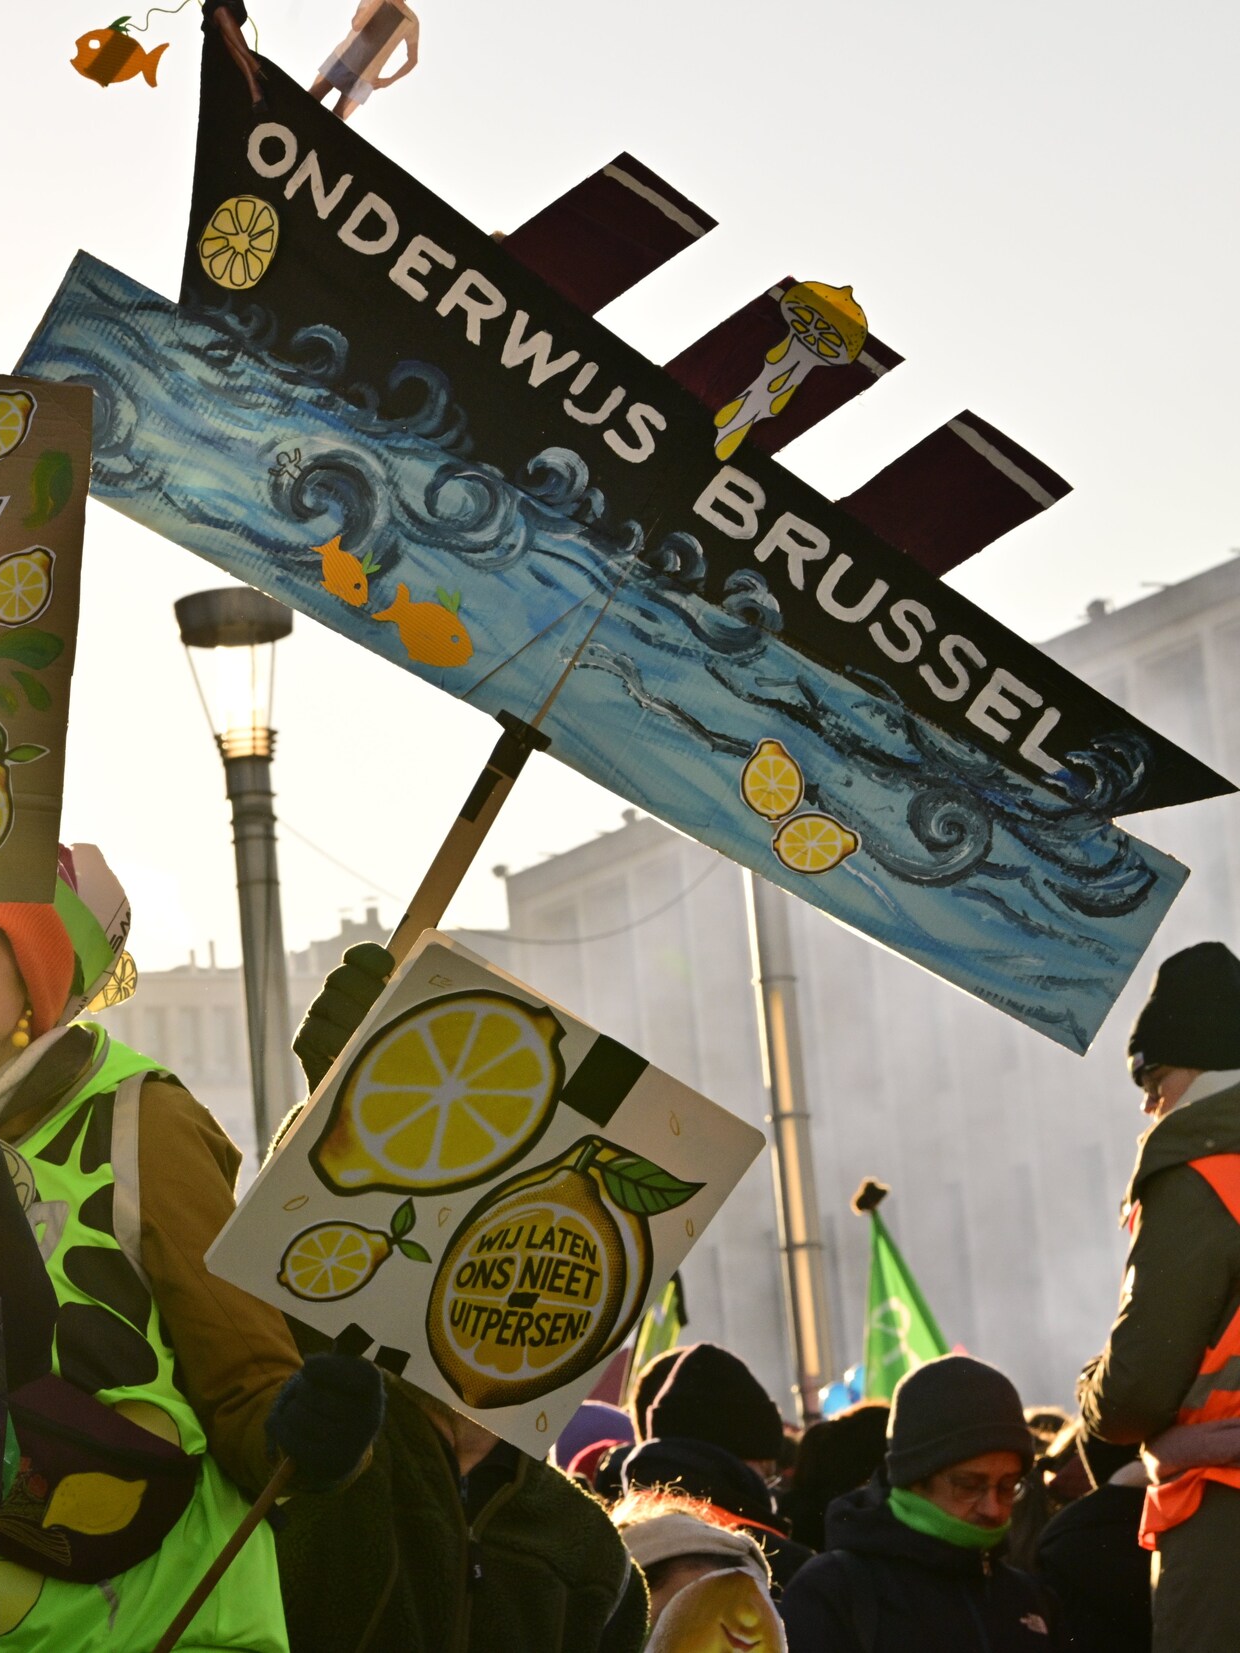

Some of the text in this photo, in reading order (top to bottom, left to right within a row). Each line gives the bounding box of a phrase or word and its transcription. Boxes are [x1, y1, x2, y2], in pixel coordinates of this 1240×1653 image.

[247, 122, 1065, 774] ONDERWIJS BRUSSEL
[476, 1225, 597, 1265] WIJ LATEN
[456, 1256, 600, 1299] ONS NIEET
[450, 1299, 592, 1347] UITPERSEN!
